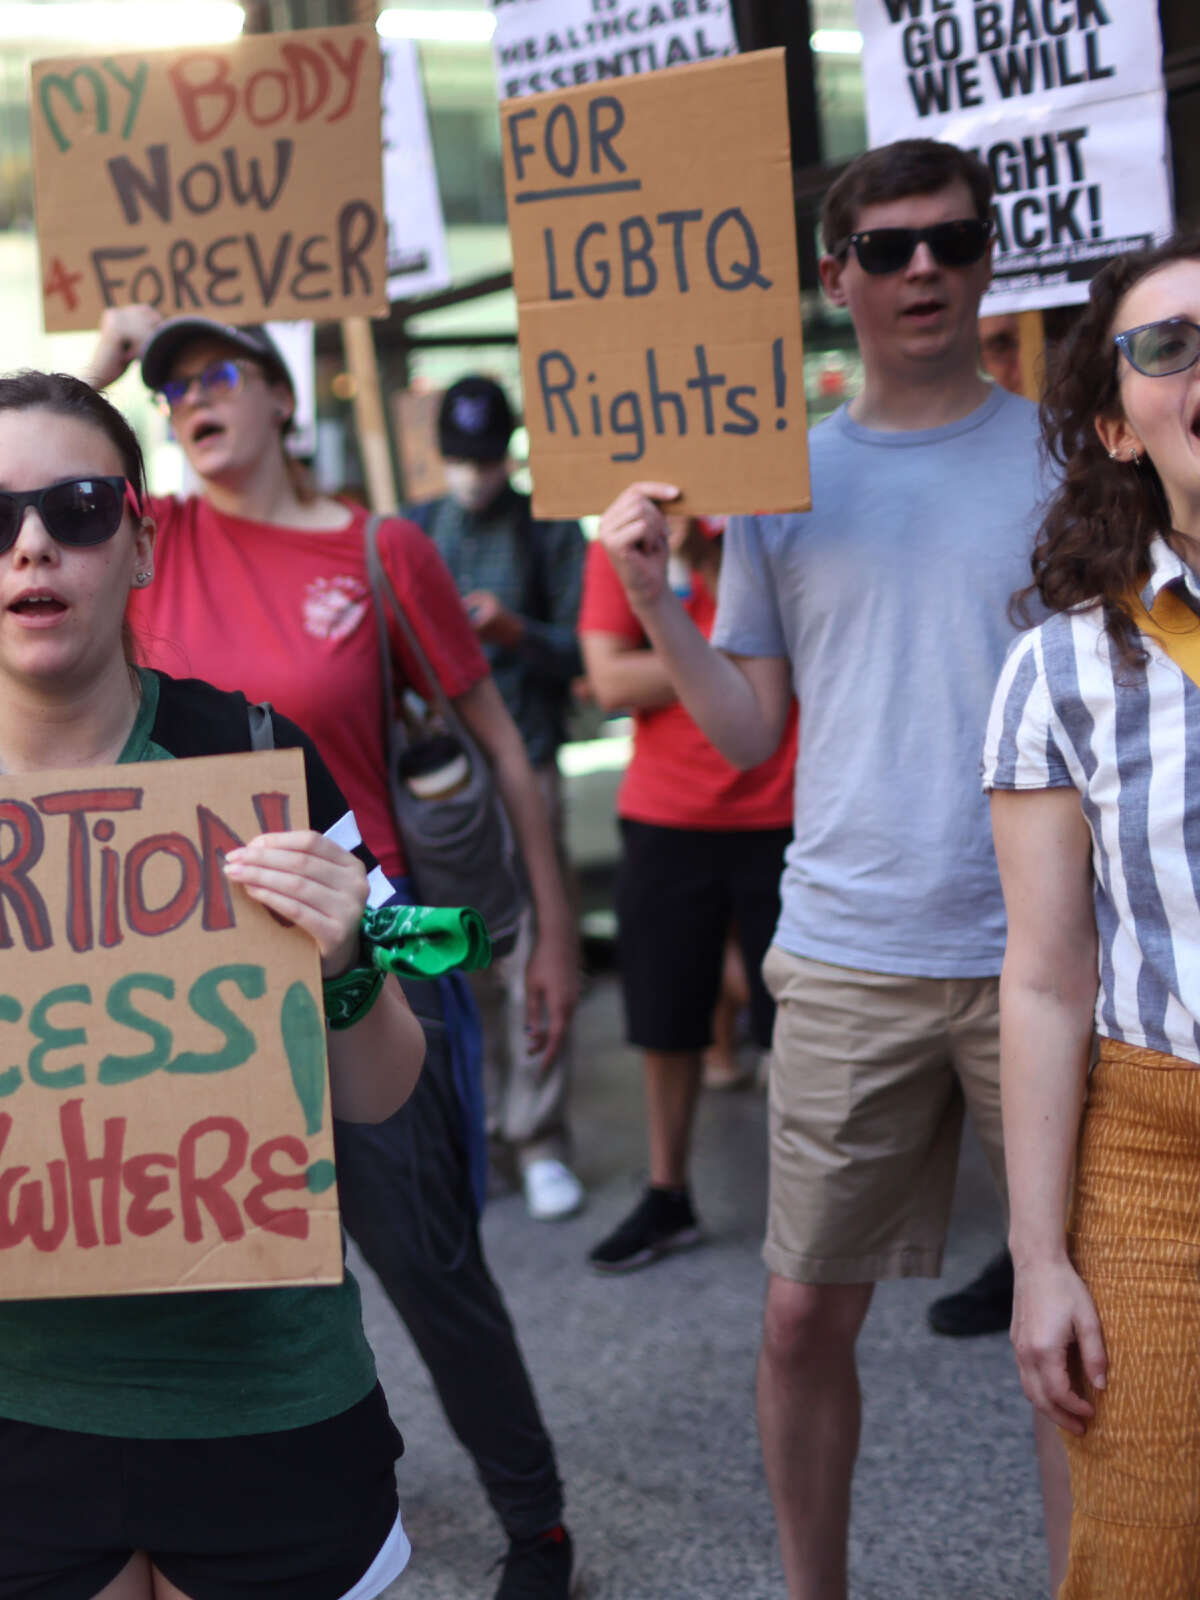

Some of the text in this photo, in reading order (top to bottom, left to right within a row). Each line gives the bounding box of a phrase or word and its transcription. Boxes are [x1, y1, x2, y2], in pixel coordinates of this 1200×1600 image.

[903, 0, 1111, 69] GO BACK
[908, 31, 1116, 118] WE WILL
[39, 36, 367, 153] MY BODY
[106, 138, 295, 226] NOW
[508, 96, 628, 181] FOR
[973, 126, 1089, 195] GHT
[90, 199, 377, 308] FOREVER
[544, 207, 774, 301] LGBTQ
[991, 183, 1103, 252] ACK!
[537, 337, 788, 462] Rights!
